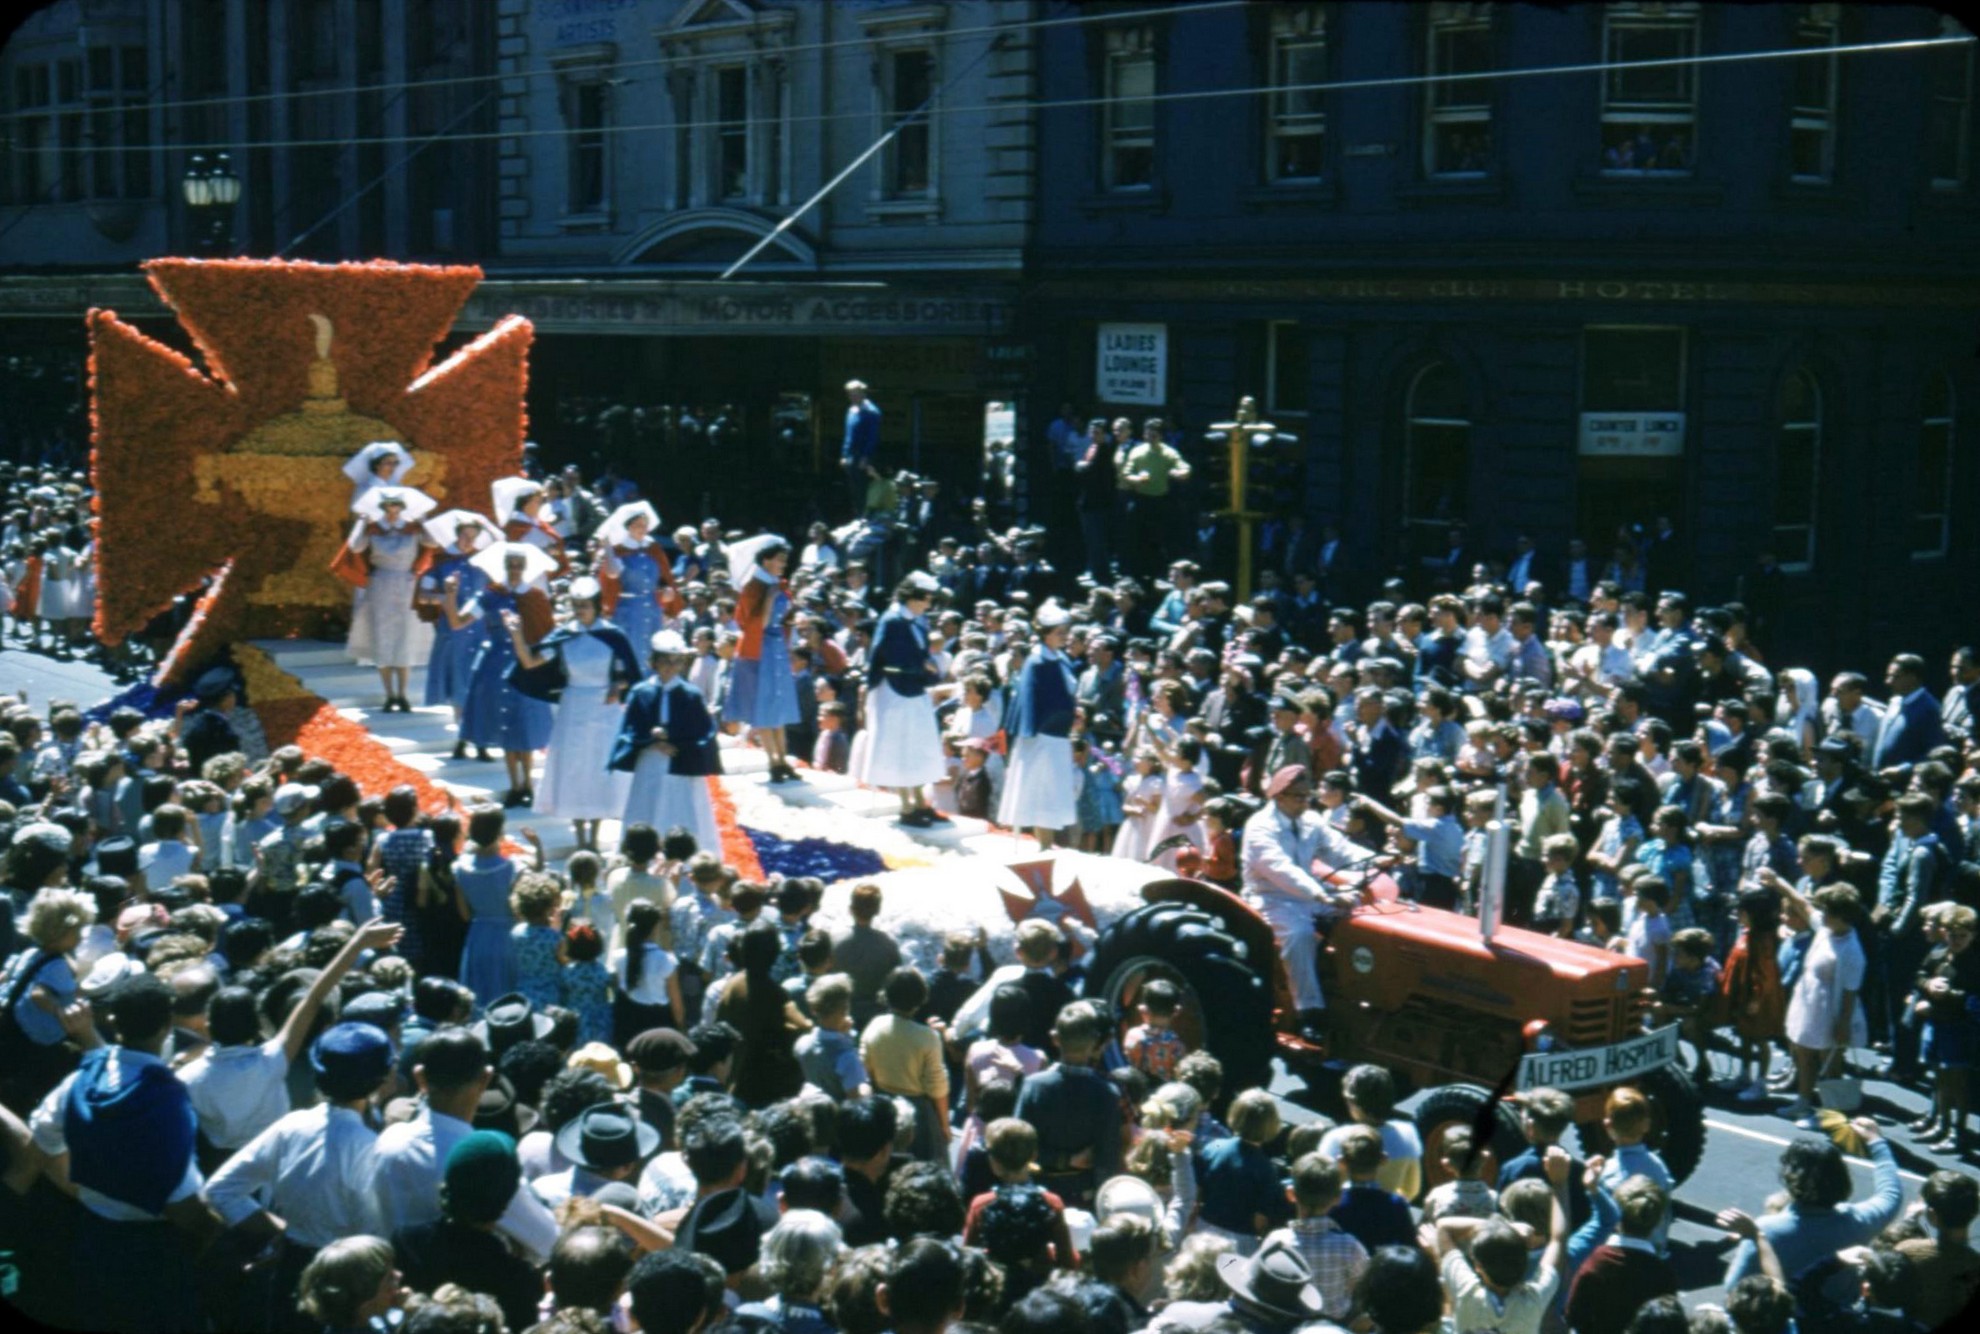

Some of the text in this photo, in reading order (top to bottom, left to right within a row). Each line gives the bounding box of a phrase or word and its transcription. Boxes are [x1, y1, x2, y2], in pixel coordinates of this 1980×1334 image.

[1558, 281, 1728, 299] HOTEL
[700, 301, 794, 321] MOTOR
[1106, 334, 1156, 351] LADIES
[1105, 355, 1156, 374] LOUNGE
[1525, 1036, 1669, 1088] ALFRED HOSPITAL
